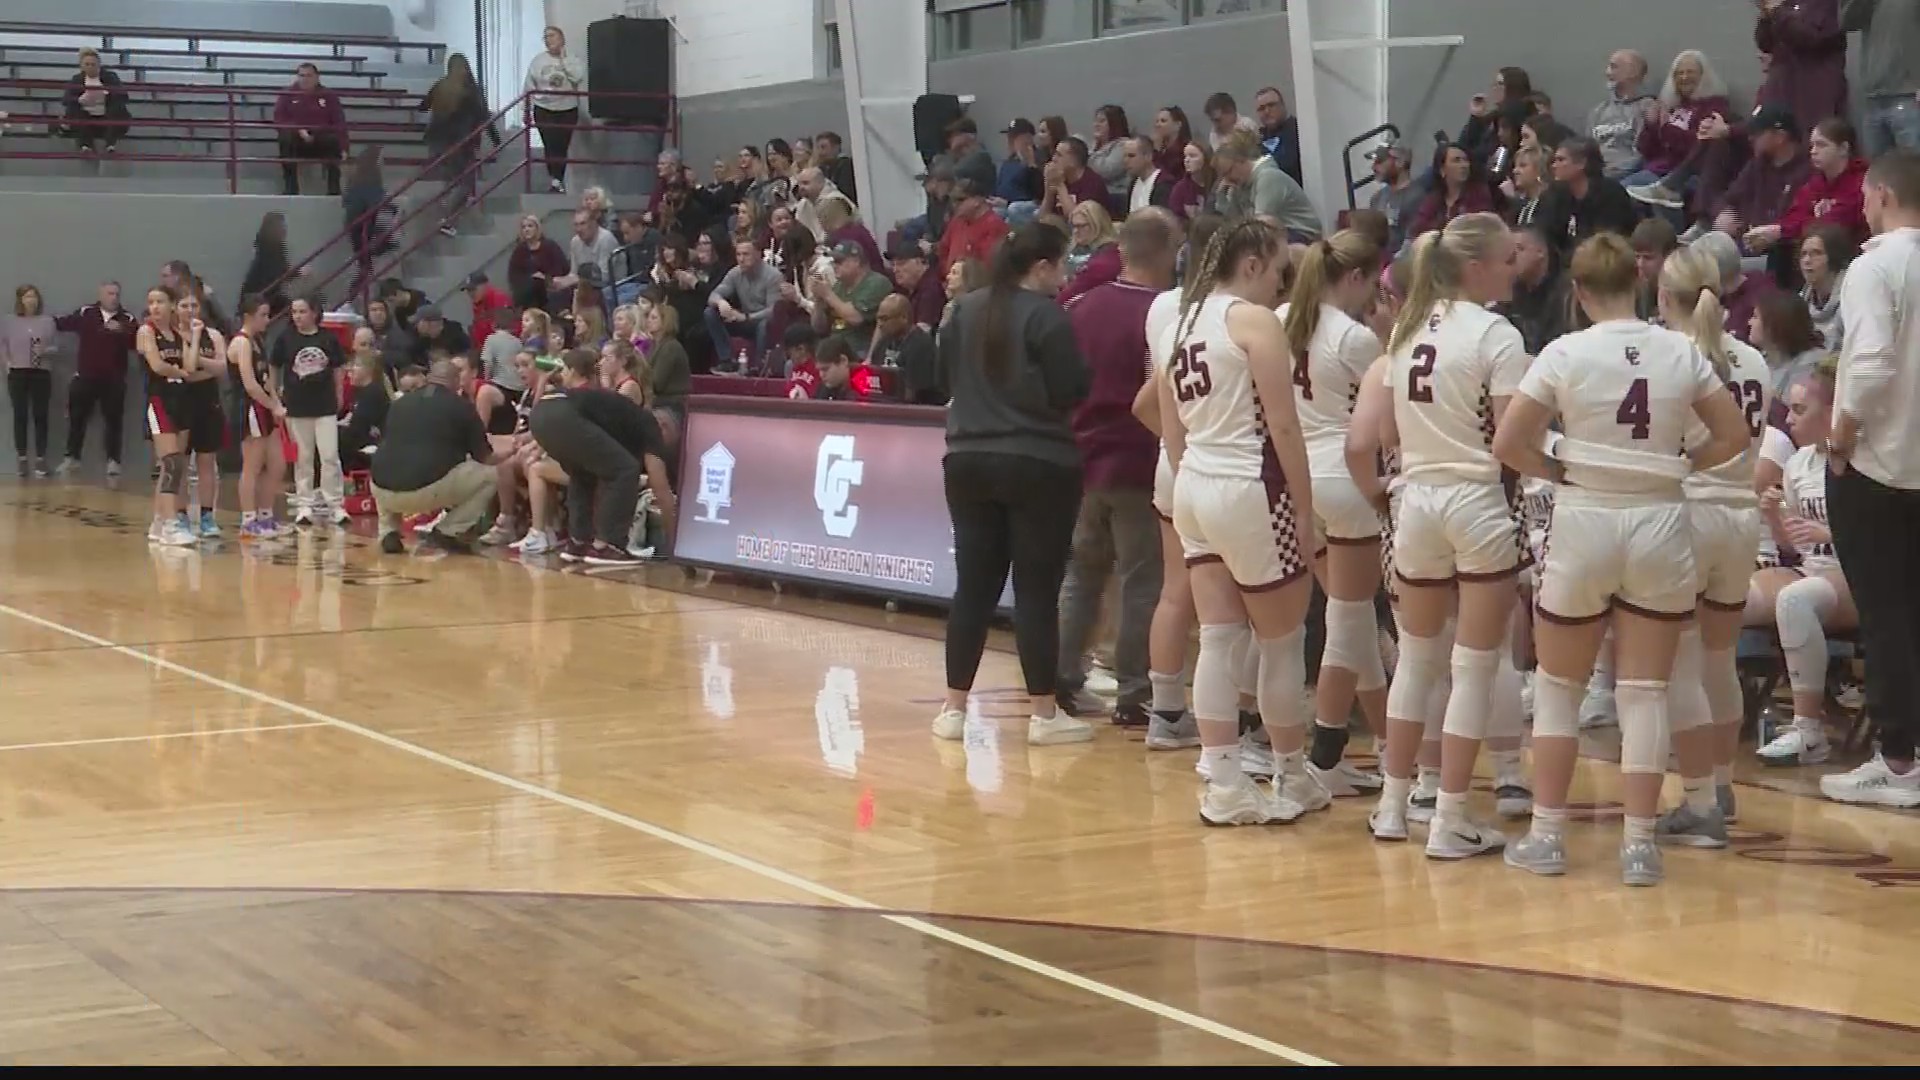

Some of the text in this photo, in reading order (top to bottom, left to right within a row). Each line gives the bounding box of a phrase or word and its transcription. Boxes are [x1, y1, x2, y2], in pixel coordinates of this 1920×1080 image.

[1174, 341, 1212, 402] 25
[1408, 343, 1437, 403] 2
[1616, 378, 1650, 439] 4
[737, 535, 934, 586] HOME OF THE MAROON KNIGHTS
